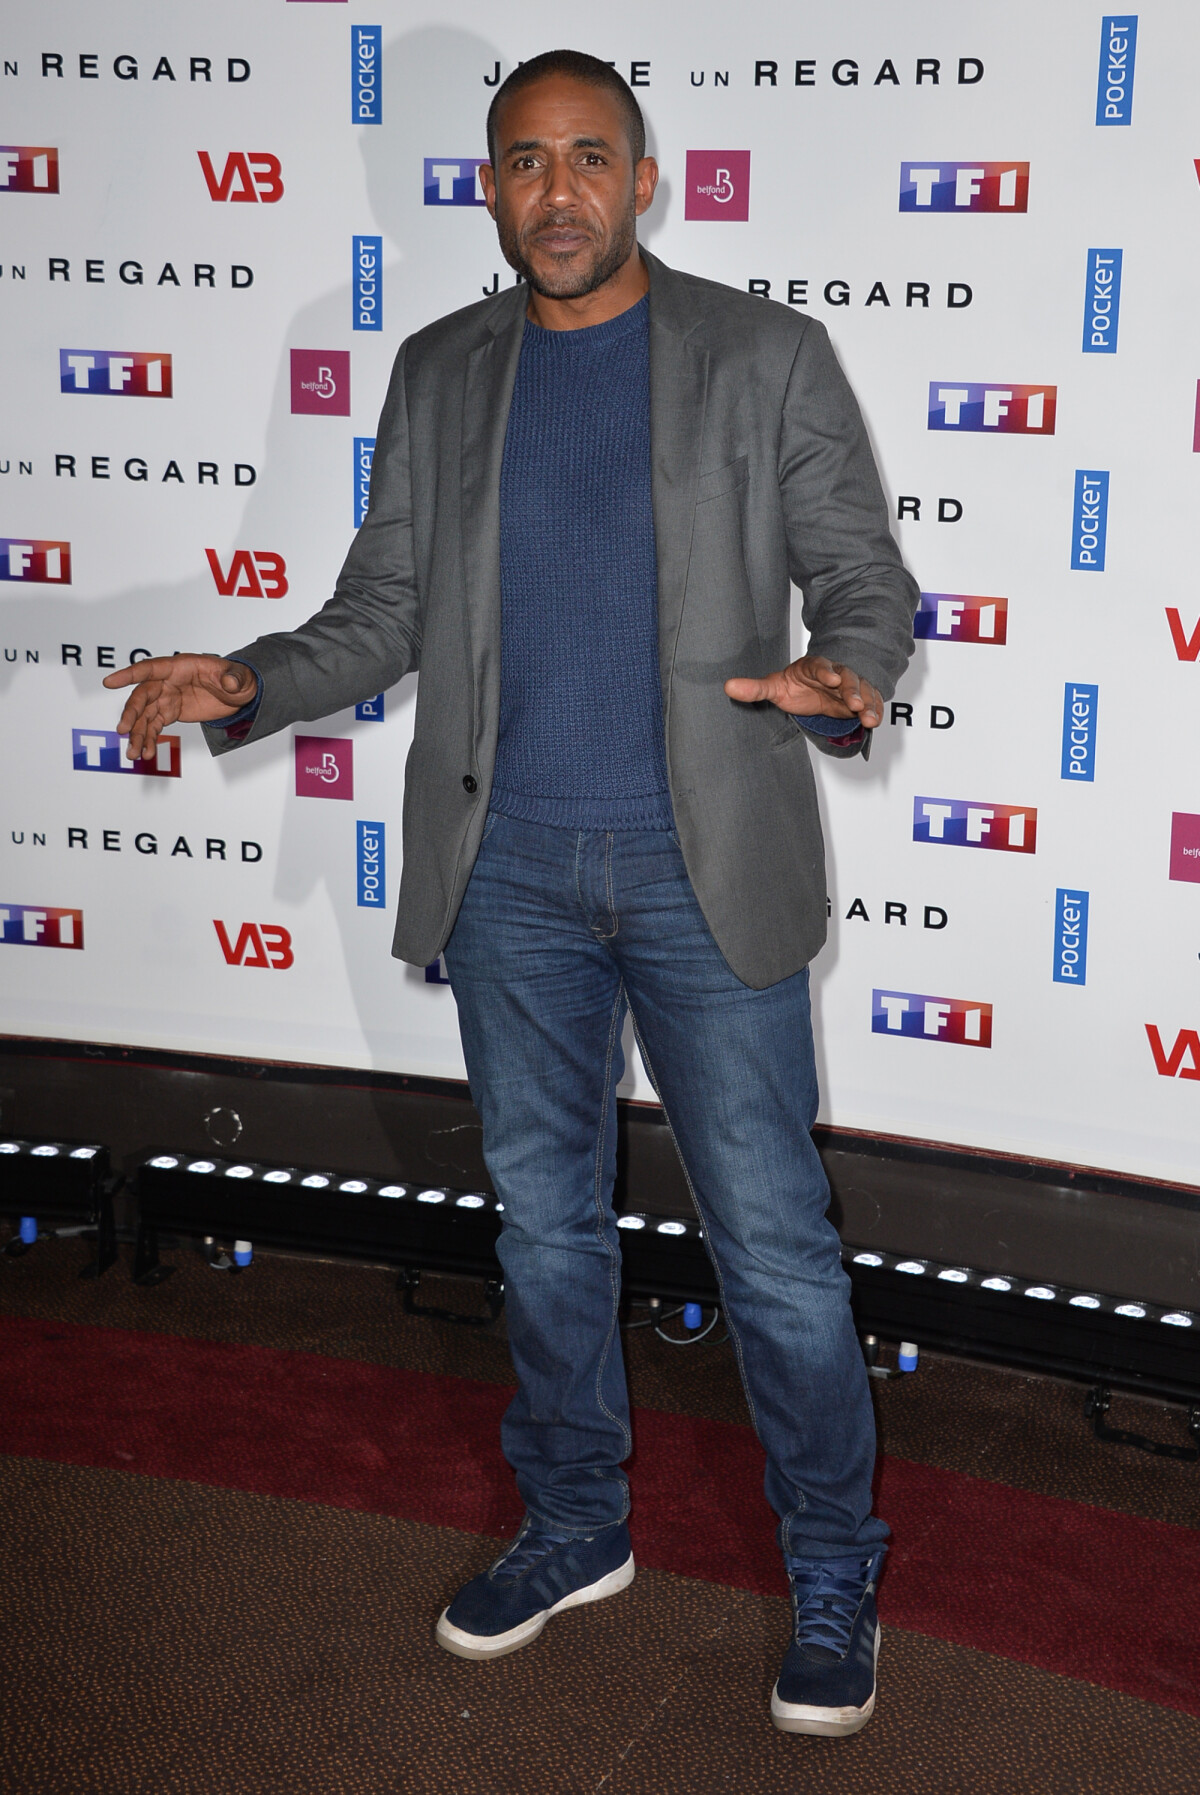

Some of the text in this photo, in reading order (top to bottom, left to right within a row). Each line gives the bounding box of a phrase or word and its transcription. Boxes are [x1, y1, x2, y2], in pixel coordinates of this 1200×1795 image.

[41, 52, 251, 83] REGARD
[690, 57, 984, 87] UN REGARD
[0, 152, 48, 188] F1
[697, 185, 726, 196] belfond
[909, 168, 1018, 207] TF1
[48, 257, 254, 289] REGARD
[748, 278, 973, 309] REGARD
[67, 354, 163, 392] TF1
[301, 381, 328, 392] belfond
[937, 388, 1045, 429] TF1
[55, 454, 257, 487] REGARD
[9, 544, 62, 579] F1
[917, 599, 996, 638] F1
[4, 648, 39, 664] UN
[305, 766, 332, 777] belfond
[922, 803, 1026, 847] TF1
[12, 828, 263, 863] UN REGARD
[826, 897, 948, 930] ARD
[880, 996, 981, 1042] TF1
[1144, 1023, 1200, 1081] VA
